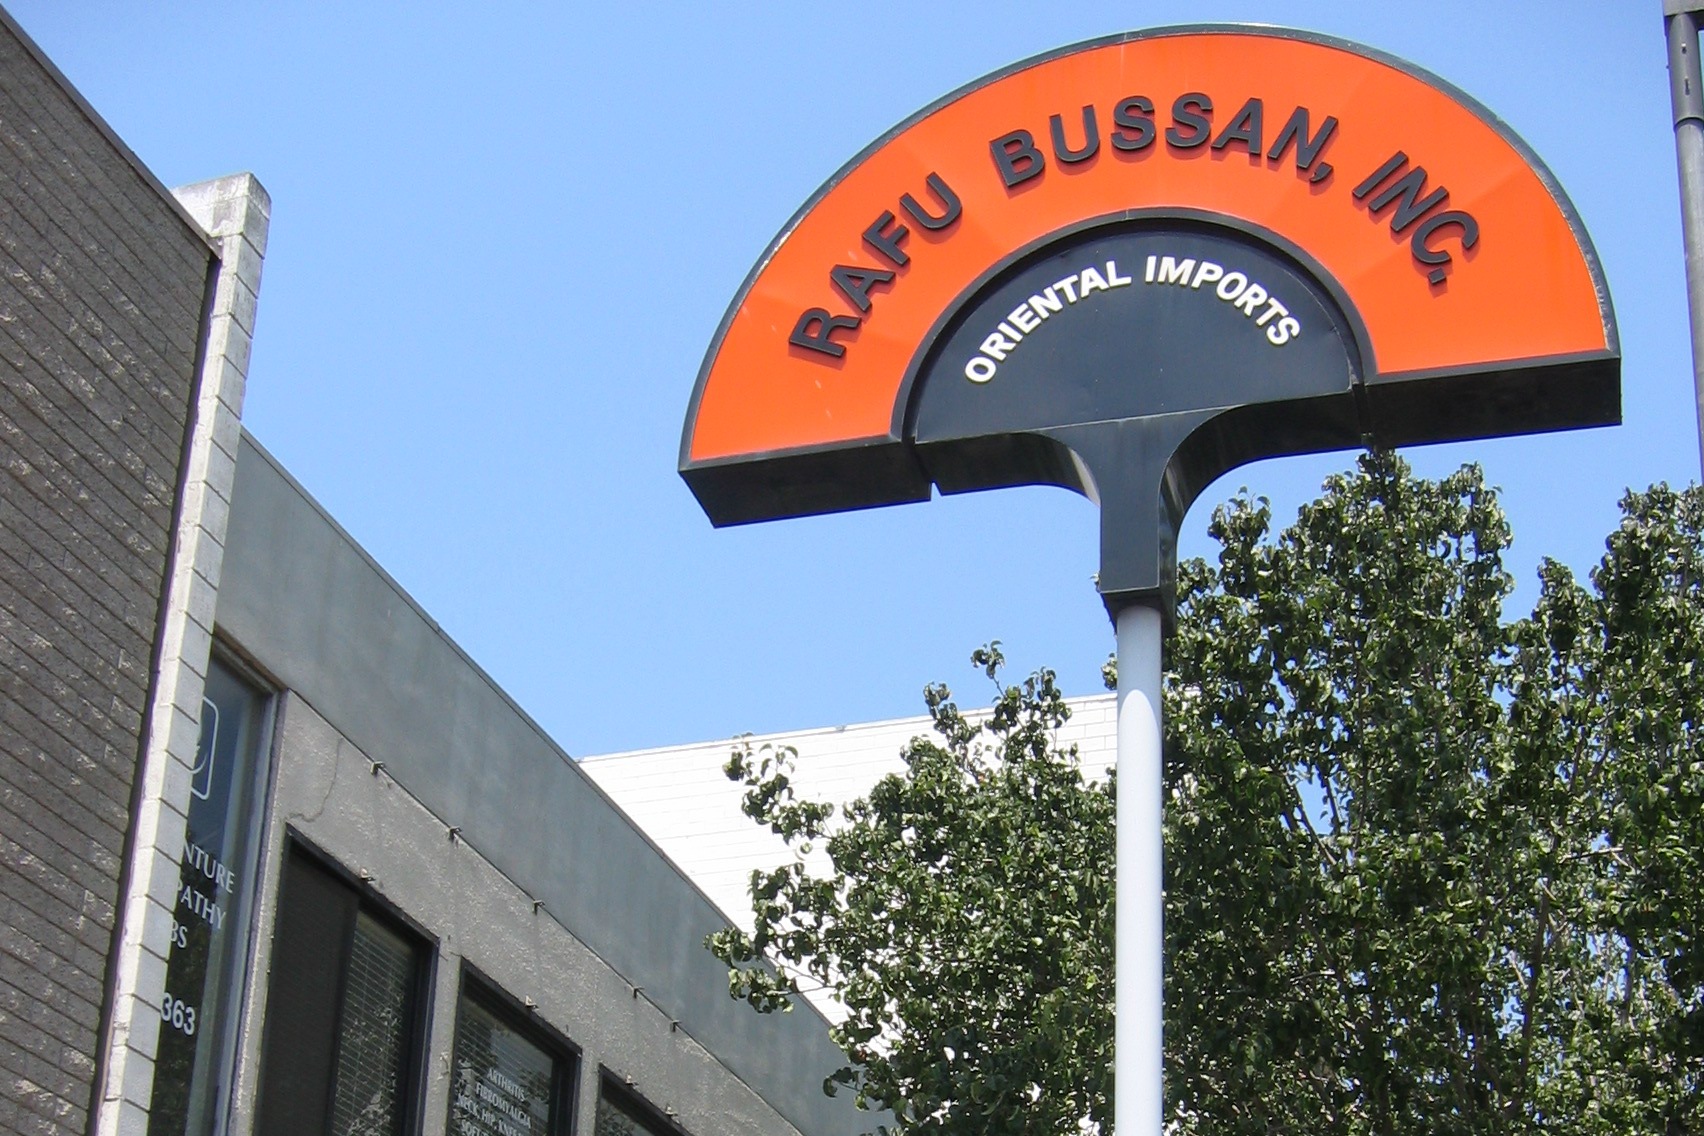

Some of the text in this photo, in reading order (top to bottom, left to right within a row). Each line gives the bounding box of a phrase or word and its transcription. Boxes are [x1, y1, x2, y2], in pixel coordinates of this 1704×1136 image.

[788, 92, 1479, 358] RAFU BUSSAN, INC.
[964, 255, 1300, 384] ORIENTAL IMPORTS
[476, 1083, 532, 1129] FIBROMYALGIA
[487, 1067, 526, 1102] ARTHRITIS
